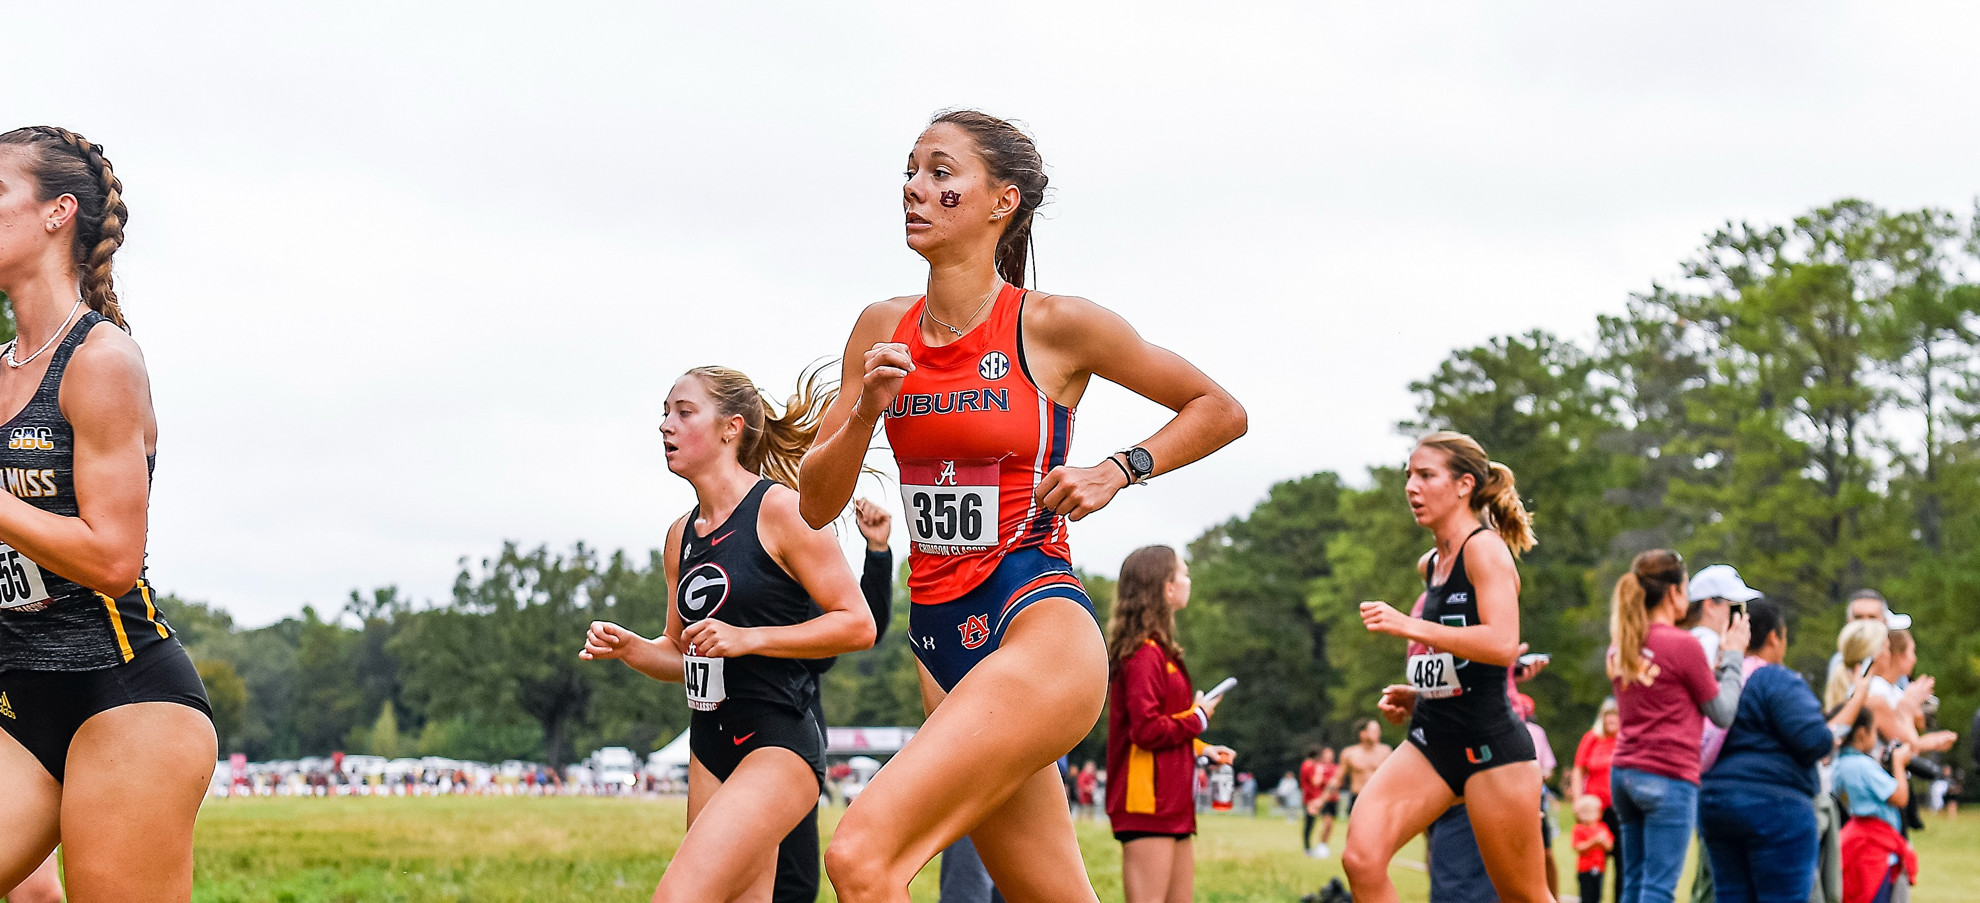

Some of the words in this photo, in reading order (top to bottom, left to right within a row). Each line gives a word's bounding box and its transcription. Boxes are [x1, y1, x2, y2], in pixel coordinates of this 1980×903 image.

[980, 353, 1010, 380] SEC
[8, 426, 54, 450] SBC
[5, 467, 58, 497] MISS
[913, 492, 982, 540] 356
[0, 551, 31, 604] 55
[677, 561, 731, 623] G
[1414, 658, 1448, 688] 482
[1465, 744, 1493, 764] U
